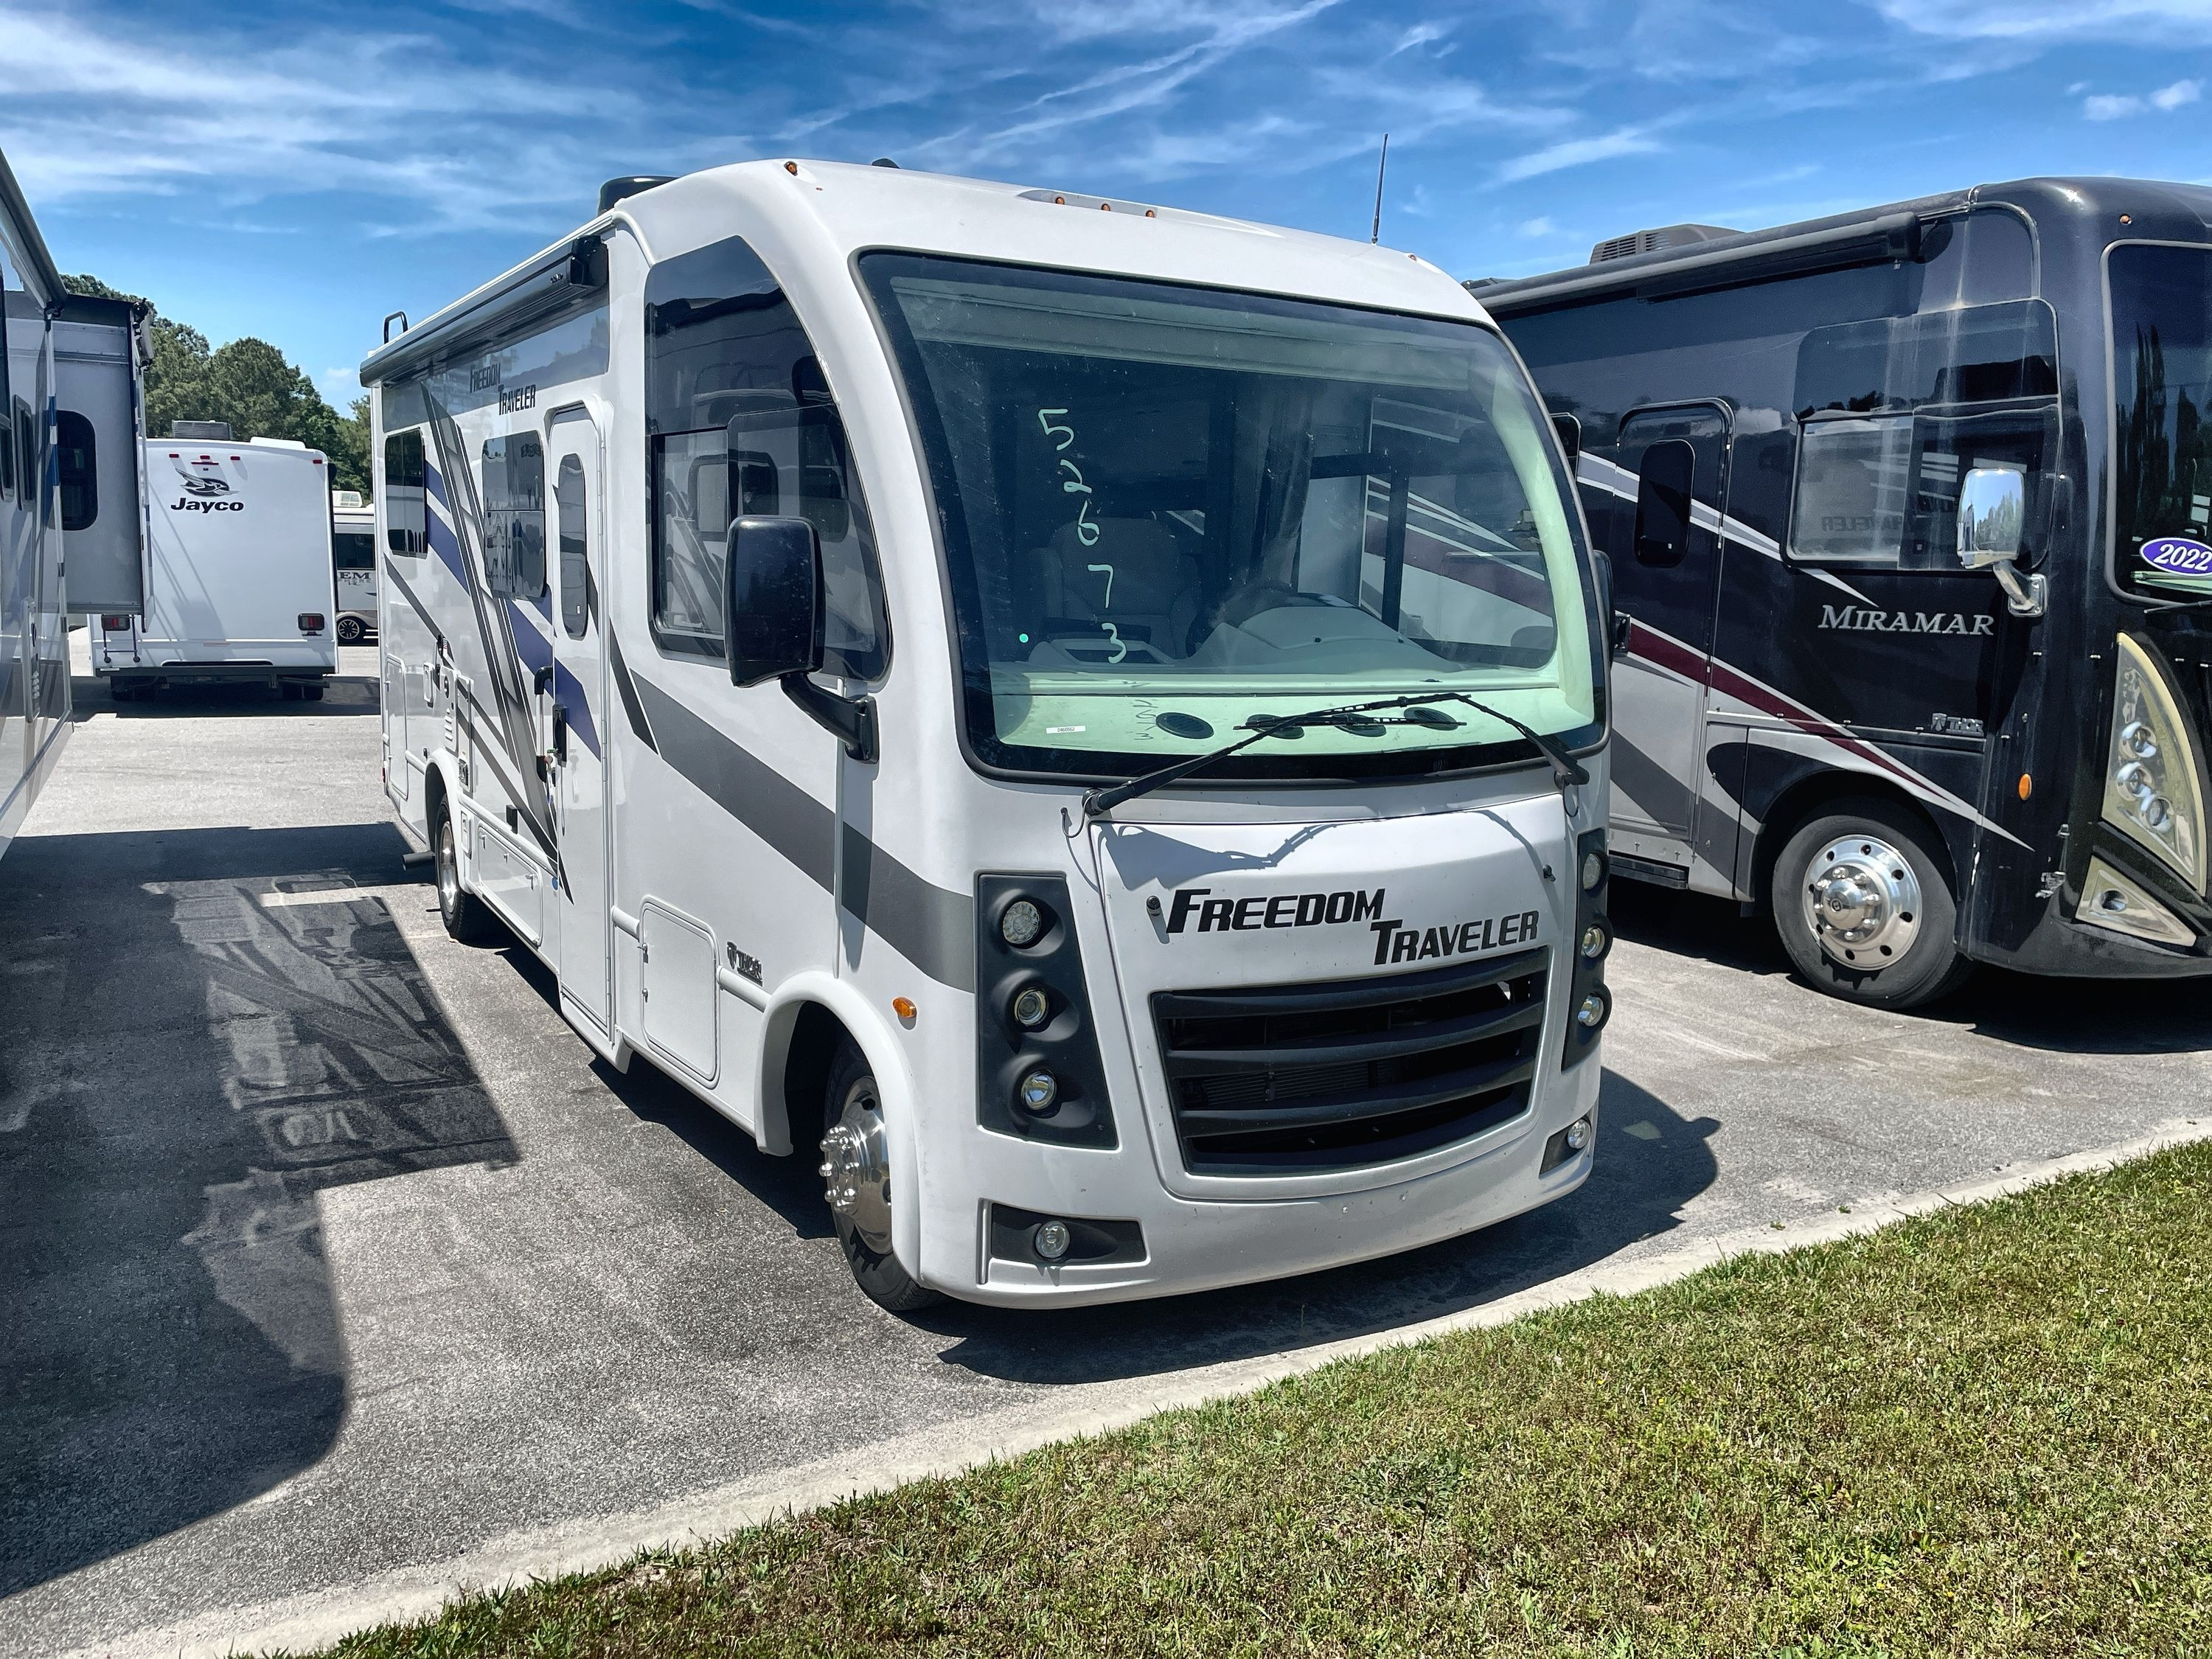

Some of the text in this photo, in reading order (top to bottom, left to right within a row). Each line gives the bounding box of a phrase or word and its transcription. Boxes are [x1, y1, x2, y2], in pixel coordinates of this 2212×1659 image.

[498, 383, 537, 416] TRAVELER
[170, 498, 244, 513] Jayco
[1037, 408, 1127, 664] 52673
[2153, 543, 2212, 571] 2022
[338, 571, 371, 580] EM
[1818, 605, 1994, 636] MIRAMAR
[1947, 716, 1984, 735] THOR
[1166, 888, 1385, 933] FREEDOM
[1369, 910, 1540, 966] TRAVELER
[737, 949, 762, 984] THOR
